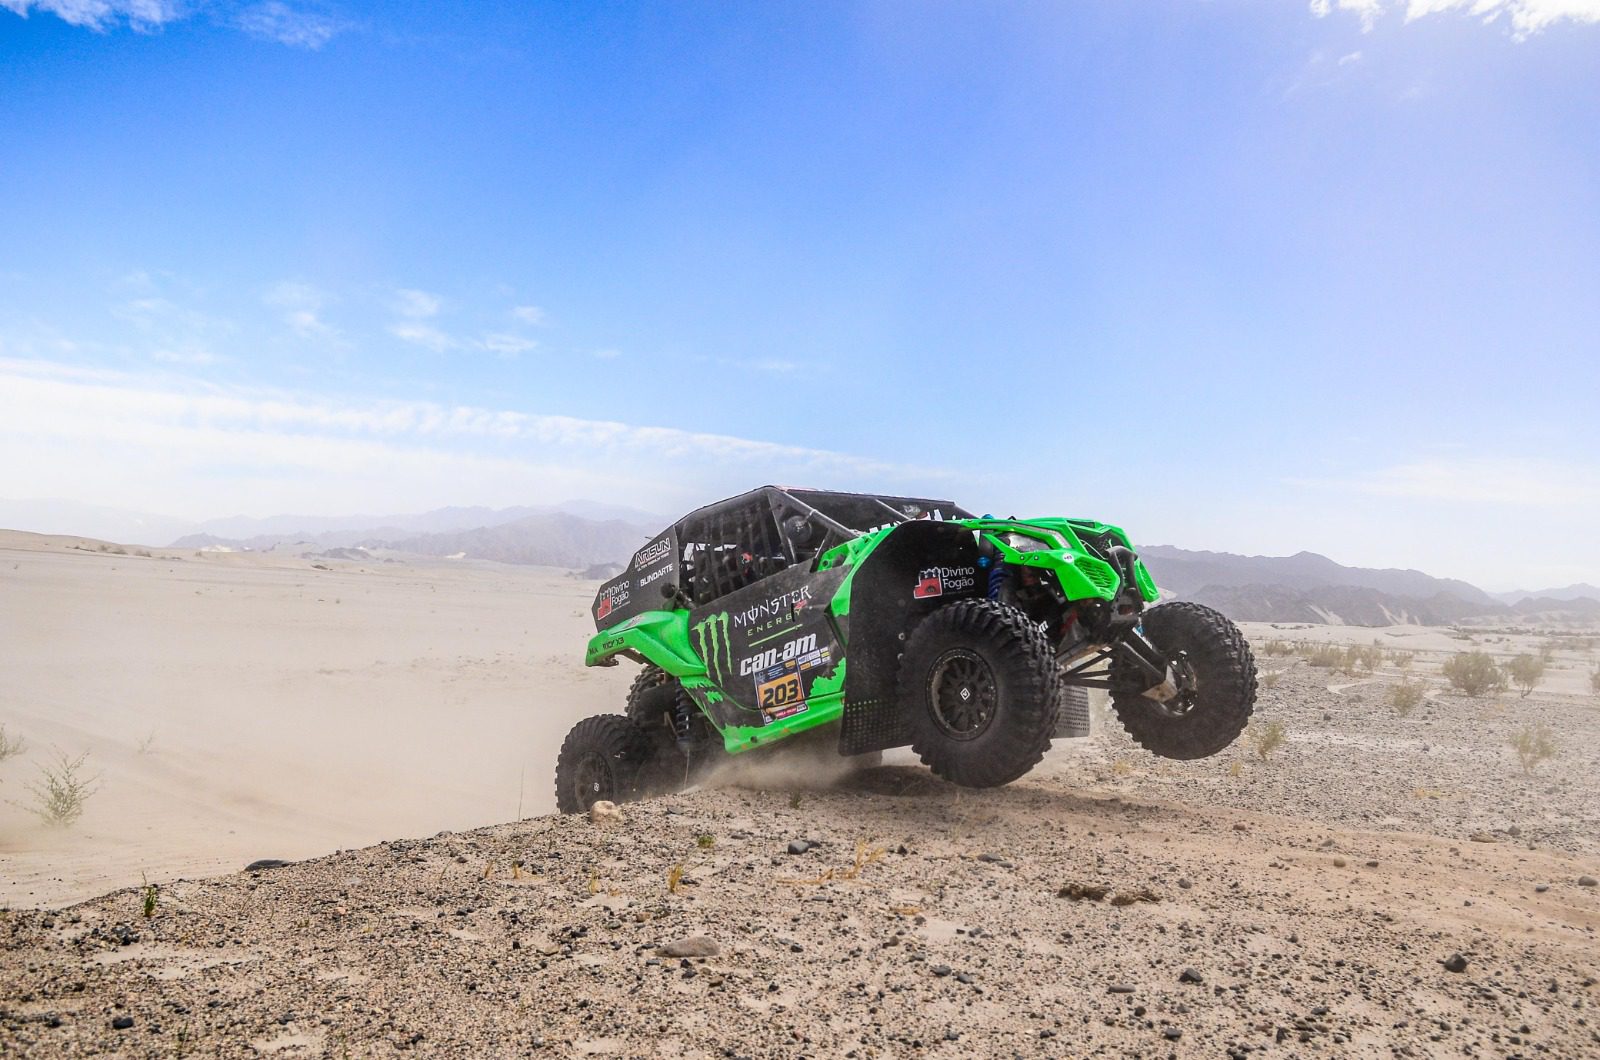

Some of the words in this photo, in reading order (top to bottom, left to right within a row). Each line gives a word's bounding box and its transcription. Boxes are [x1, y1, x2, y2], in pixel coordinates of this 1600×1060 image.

[640, 563, 674, 587] BLINDARTE
[941, 565, 975, 578] Divino
[611, 580, 630, 595] Divino
[942, 576, 975, 590] Fogão
[611, 591, 630, 606] Fogão
[747, 608, 802, 637] ENERGY
[740, 633, 817, 677] can-am
[763, 678, 799, 708] 203
